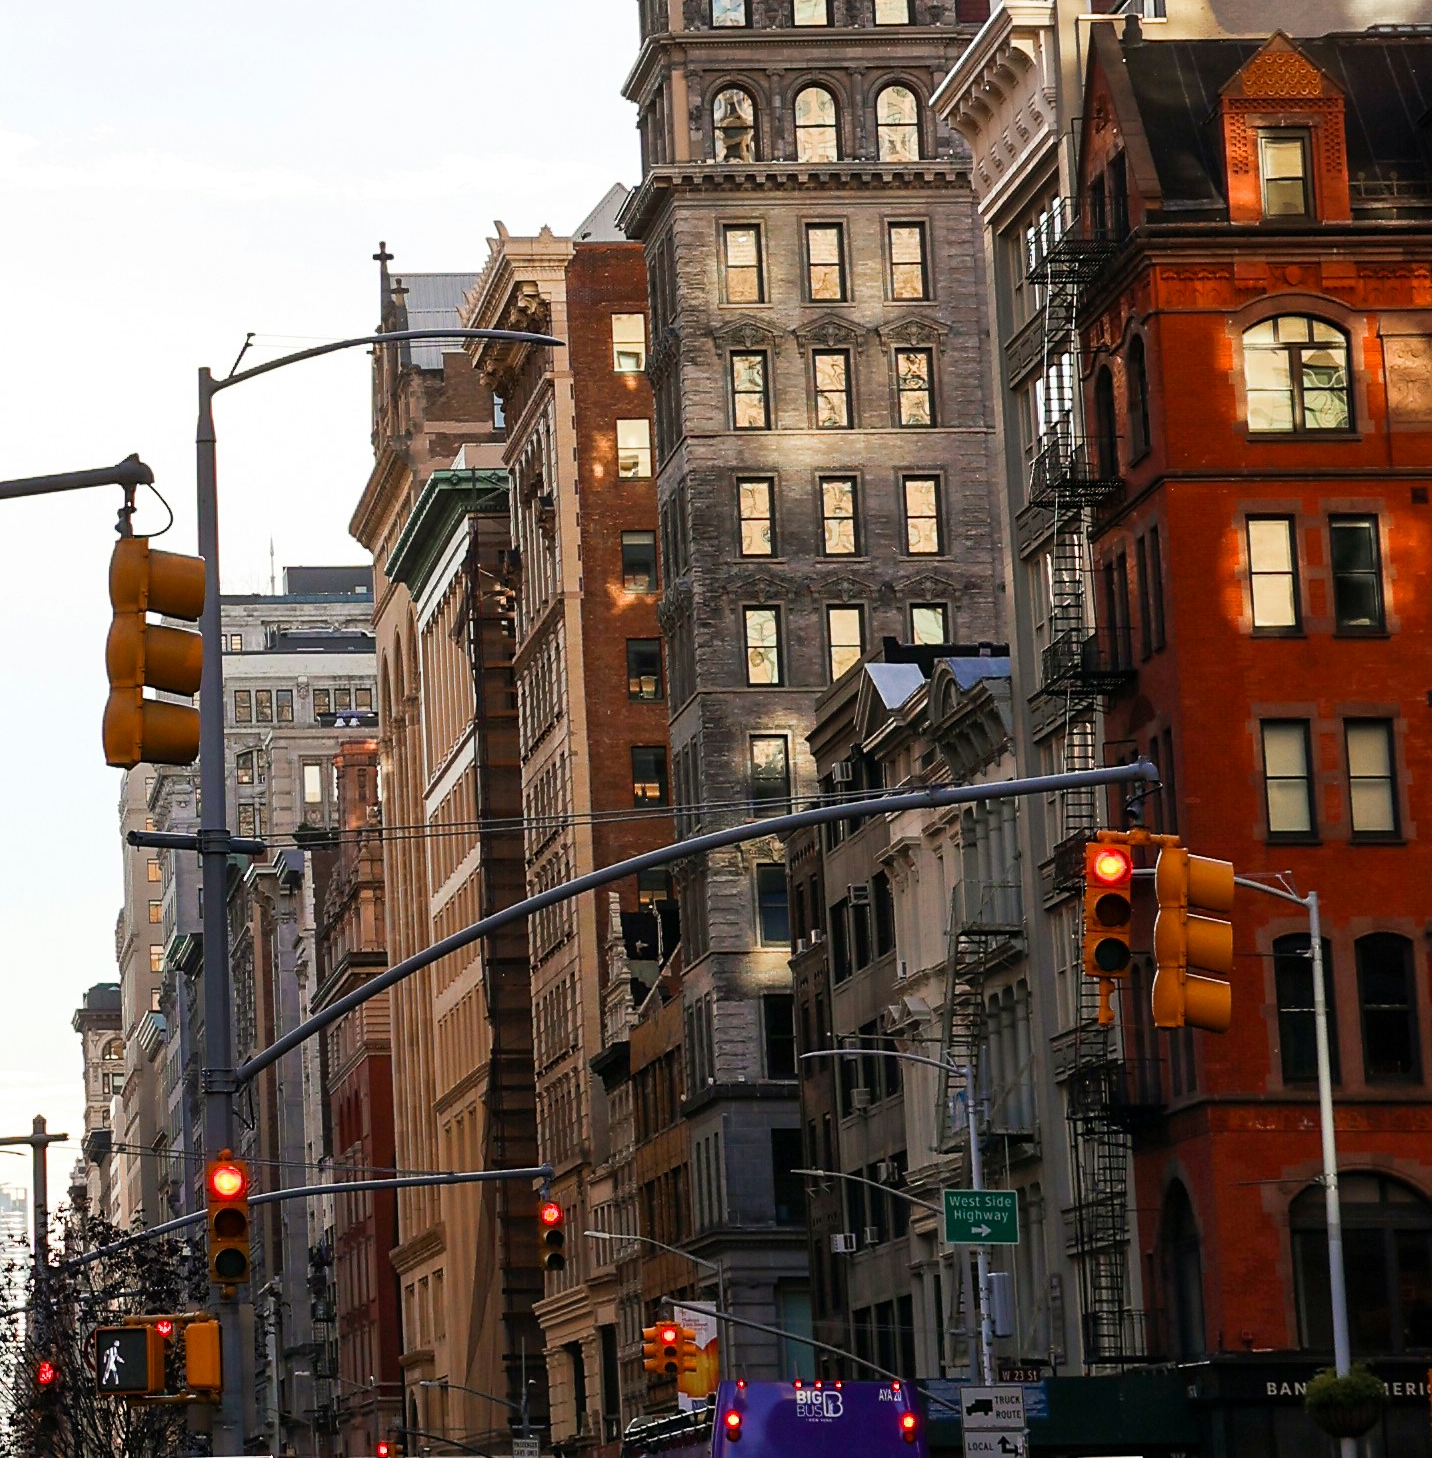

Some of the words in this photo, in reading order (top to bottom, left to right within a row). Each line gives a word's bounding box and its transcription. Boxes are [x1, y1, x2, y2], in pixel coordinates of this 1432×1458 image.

[949, 1196, 980, 1207] West
[985, 1195, 1012, 1207] Side
[954, 1209, 1008, 1223] Highway
[1002, 1371, 1010, 1381] W
[1014, 1370, 1024, 1381] 23
[1028, 1370, 1037, 1381] St
[878, 1388, 893, 1401] AYA
[1267, 1382, 1307, 1395] BAN
[796, 1390, 822, 1404] BIG
[994, 1396, 1021, 1405] TRUCK
[796, 1404, 823, 1417] BUS
[995, 1410, 1022, 1419] ROUTE
[968, 1442, 994, 1451] LOCAL
